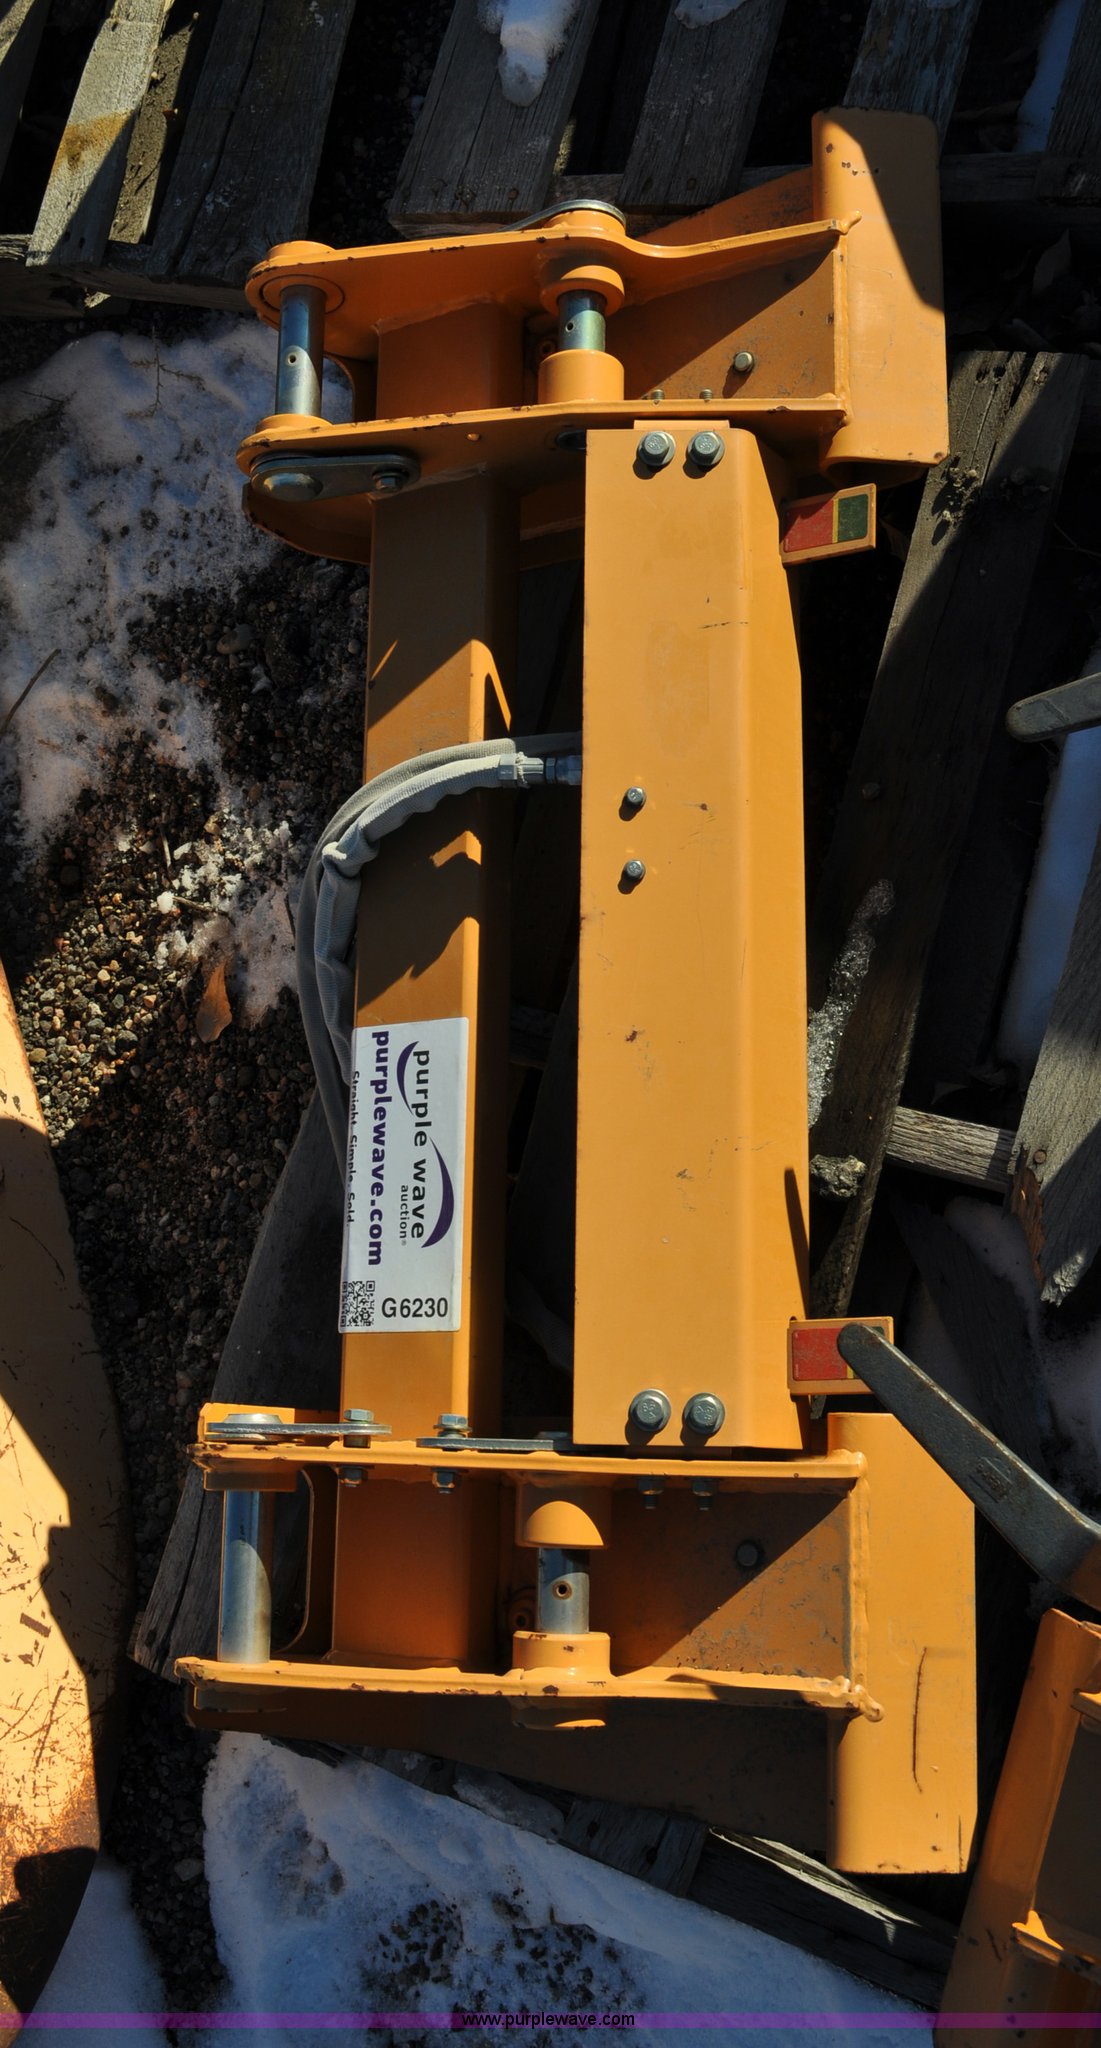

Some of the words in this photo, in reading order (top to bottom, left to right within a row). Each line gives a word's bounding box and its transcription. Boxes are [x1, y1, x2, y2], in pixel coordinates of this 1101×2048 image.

[411, 1049, 432, 1147] purple
[368, 1031, 393, 1266] purplewave.com
[411, 1158, 427, 1239] wave
[381, 1297, 449, 1319] G6230
